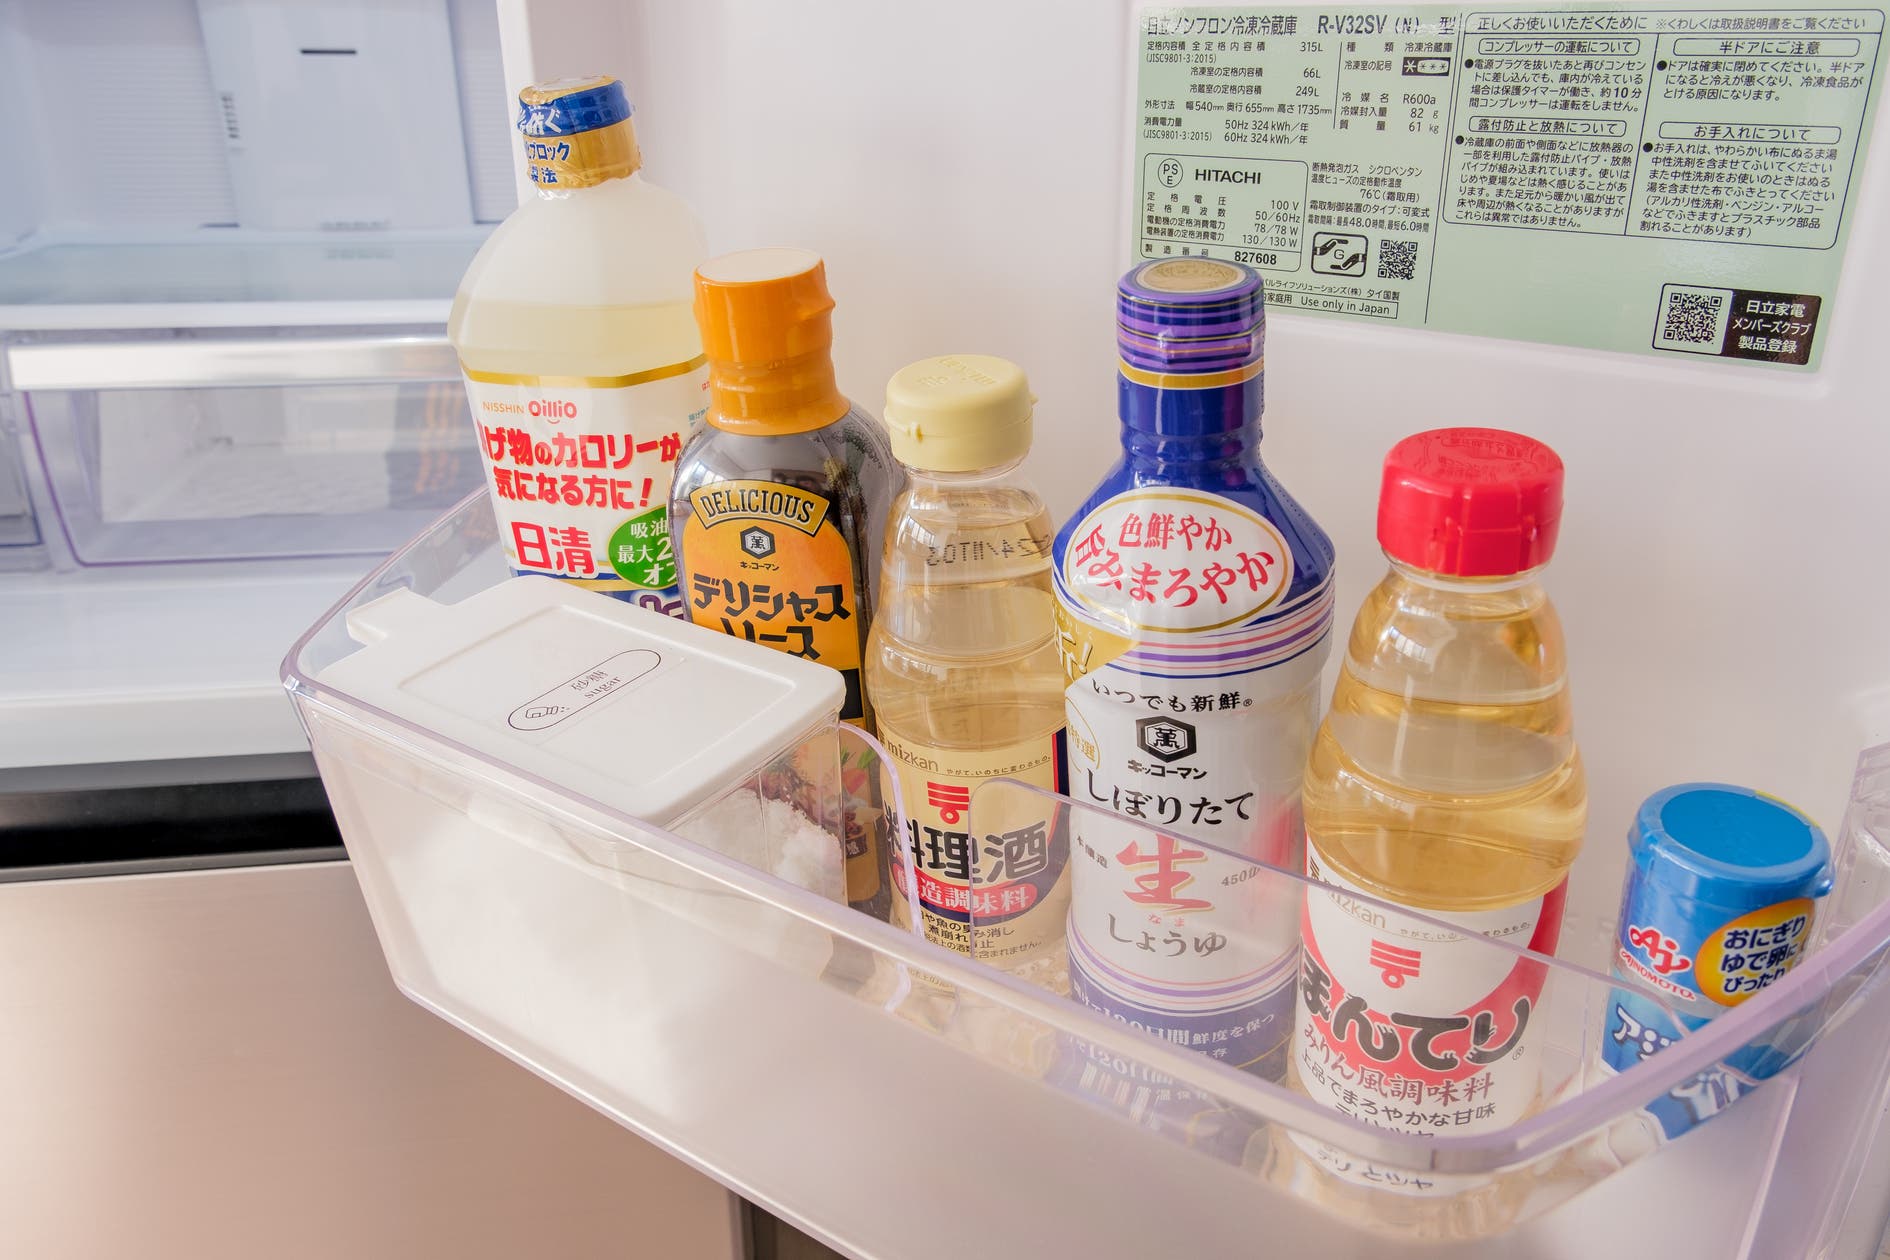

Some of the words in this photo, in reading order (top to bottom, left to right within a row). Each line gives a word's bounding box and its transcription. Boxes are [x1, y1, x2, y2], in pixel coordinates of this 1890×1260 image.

[1317, 14, 1387, 34] R-V32SV
[1477, 16, 1648, 31] 正しくお使いいただくために
[1147, 41, 1186, 51] 定格内容積
[1300, 41, 1323, 53] 315L
[1404, 41, 1453, 53] 冷凍冷蔵庫
[1485, 41, 1633, 54] コンプレッサーの運転について
[1719, 41, 1821, 55] 半ドアにご注意
[1190, 66, 1264, 78] 冷凍室の定格内容積
[1303, 68, 1321, 79] 66L
[1344, 60, 1392, 71] 冷凍室の記号
[1189, 83, 1262, 95] 冷蔵室の定格内容積
[1295, 86, 1319, 97] 249L
[1663, 88, 1782, 102] とける原因になります。
[1144, 99, 1175, 110] 外形寸法
[1402, 93, 1436, 106] R600a
[1340, 106, 1387, 118] 冷媒封入量
[1410, 107, 1424, 119] 82
[1144, 116, 1182, 127] 消費電力量
[1225, 119, 1248, 131] 50Hz
[1251, 120, 1268, 131] 324
[1408, 121, 1422, 132] 61
[1428, 122, 1439, 135] kg
[1478, 119, 1618, 135] 露付防止と放熱について
[1224, 132, 1248, 143] 60Hz
[1250, 132, 1268, 144] 324
[1694, 125, 1811, 141] お手入れについて
[527, 142, 570, 161] ブロック
[1312, 162, 1360, 174] 断熱発泡ガス
[1651, 156, 1833, 174] 中性洗剤を含ませてふいてください
[1195, 168, 1262, 185] HITACHI
[1270, 199, 1289, 211] 100
[1291, 200, 1299, 211] V
[1146, 214, 1226, 231] 電動機の定格消費電力
[1290, 225, 1299, 235] W
[1455, 210, 1582, 229] これらは異常ではありません。
[1145, 226, 1225, 242] 電熱装置の定格消費電力
[1288, 237, 1298, 248] W
[1234, 250, 1277, 265] 827608
[1366, 288, 1400, 301] タイ国製
[1301, 295, 1319, 307] Use
[1322, 298, 1344, 311] only
[1346, 300, 1356, 311] in
[1359, 302, 1390, 317] Japan
[1746, 300, 1806, 318] 日立家電
[1732, 317, 1812, 337] メンバーズクラブ
[1737, 335, 1798, 354] 製品登録
[482, 401, 524, 415] NISSHIN
[476, 419, 682, 470] げ物のカロリーが
[492, 466, 653, 510] 気になる方に!
[700, 489, 815, 523] DELICIOUS
[1118, 511, 1233, 552] 色鮮やか
[511, 521, 596, 574] 日清
[740, 561, 780, 571] キッコーマン
[693, 572, 851, 623] デリシャス
[584, 676, 622, 699] sugar
[887, 740, 939, 773] mizkan
[1127, 759, 1208, 780] キッコーマン
[1086, 767, 1254, 826] しぼりたて
[884, 799, 1049, 884] 料理酒
[1115, 832, 1214, 914] 生
[928, 924, 995, 949] 煮崩れ止
[1107, 913, 1228, 958] しょうゆ
[1723, 916, 1806, 950] おにぎり
[1721, 943, 1798, 973] ゆで卵に
[1304, 1023, 1495, 1107] みりん風調味料
[1301, 1047, 1497, 1127] 上品でまろやかな甘味
